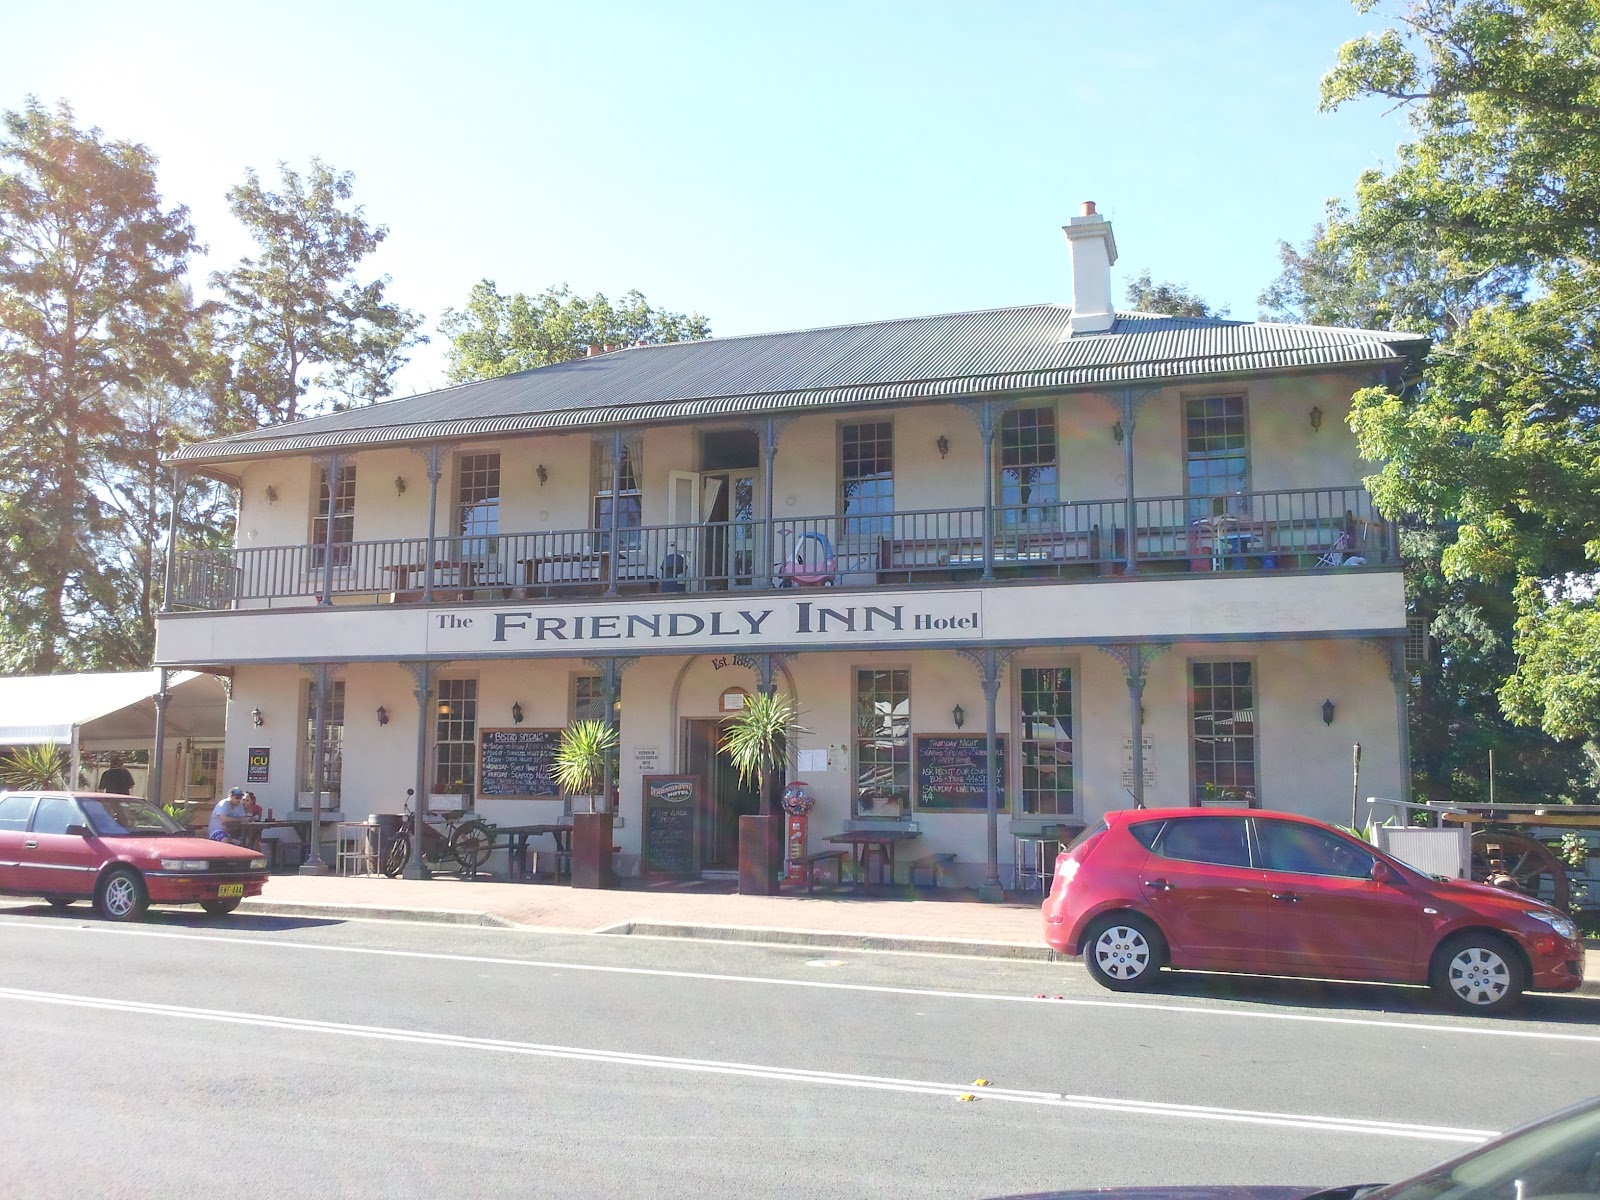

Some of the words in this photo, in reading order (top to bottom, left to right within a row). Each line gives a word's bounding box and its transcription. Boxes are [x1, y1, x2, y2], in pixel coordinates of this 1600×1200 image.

[435, 614, 474, 629] The
[491, 610, 774, 642] FRIENDLY
[795, 602, 905, 634] INN
[913, 612, 980, 631] Hotel
[250, 756, 268, 766] ICU
[667, 790, 690, 798] HOTEL
